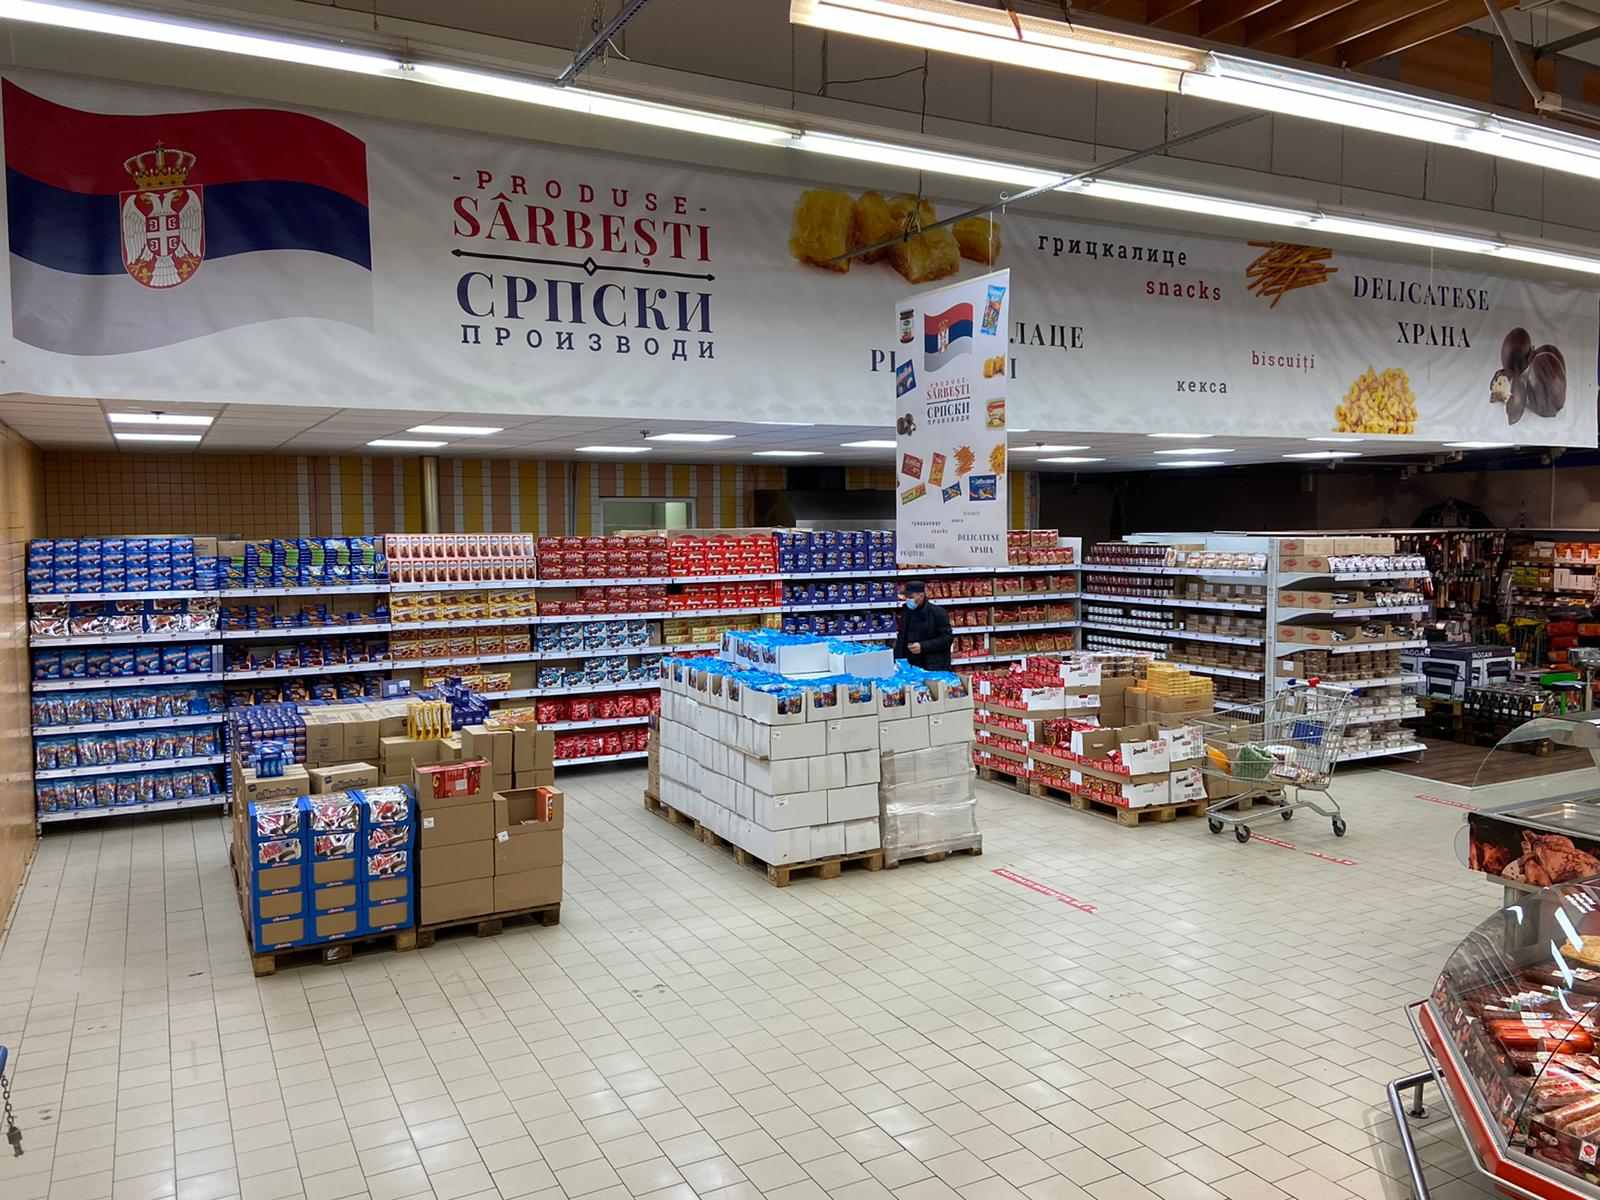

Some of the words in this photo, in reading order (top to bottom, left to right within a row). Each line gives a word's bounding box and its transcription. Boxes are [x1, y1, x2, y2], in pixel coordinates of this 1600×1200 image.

[453, 192, 712, 267] SÂRBEȘTI
[1038, 234, 1188, 266] грицкалице
[456, 271, 713, 333] СРПСКИ
[1146, 280, 1221, 301] snacks
[1353, 275, 1490, 311] DELICATESE
[461, 324, 714, 361] ПРОИЗВОДИ
[1397, 321, 1471, 348] ХРАНА
[1251, 350, 1315, 373] biscuiți
[1176, 378, 1228, 394] кекса
